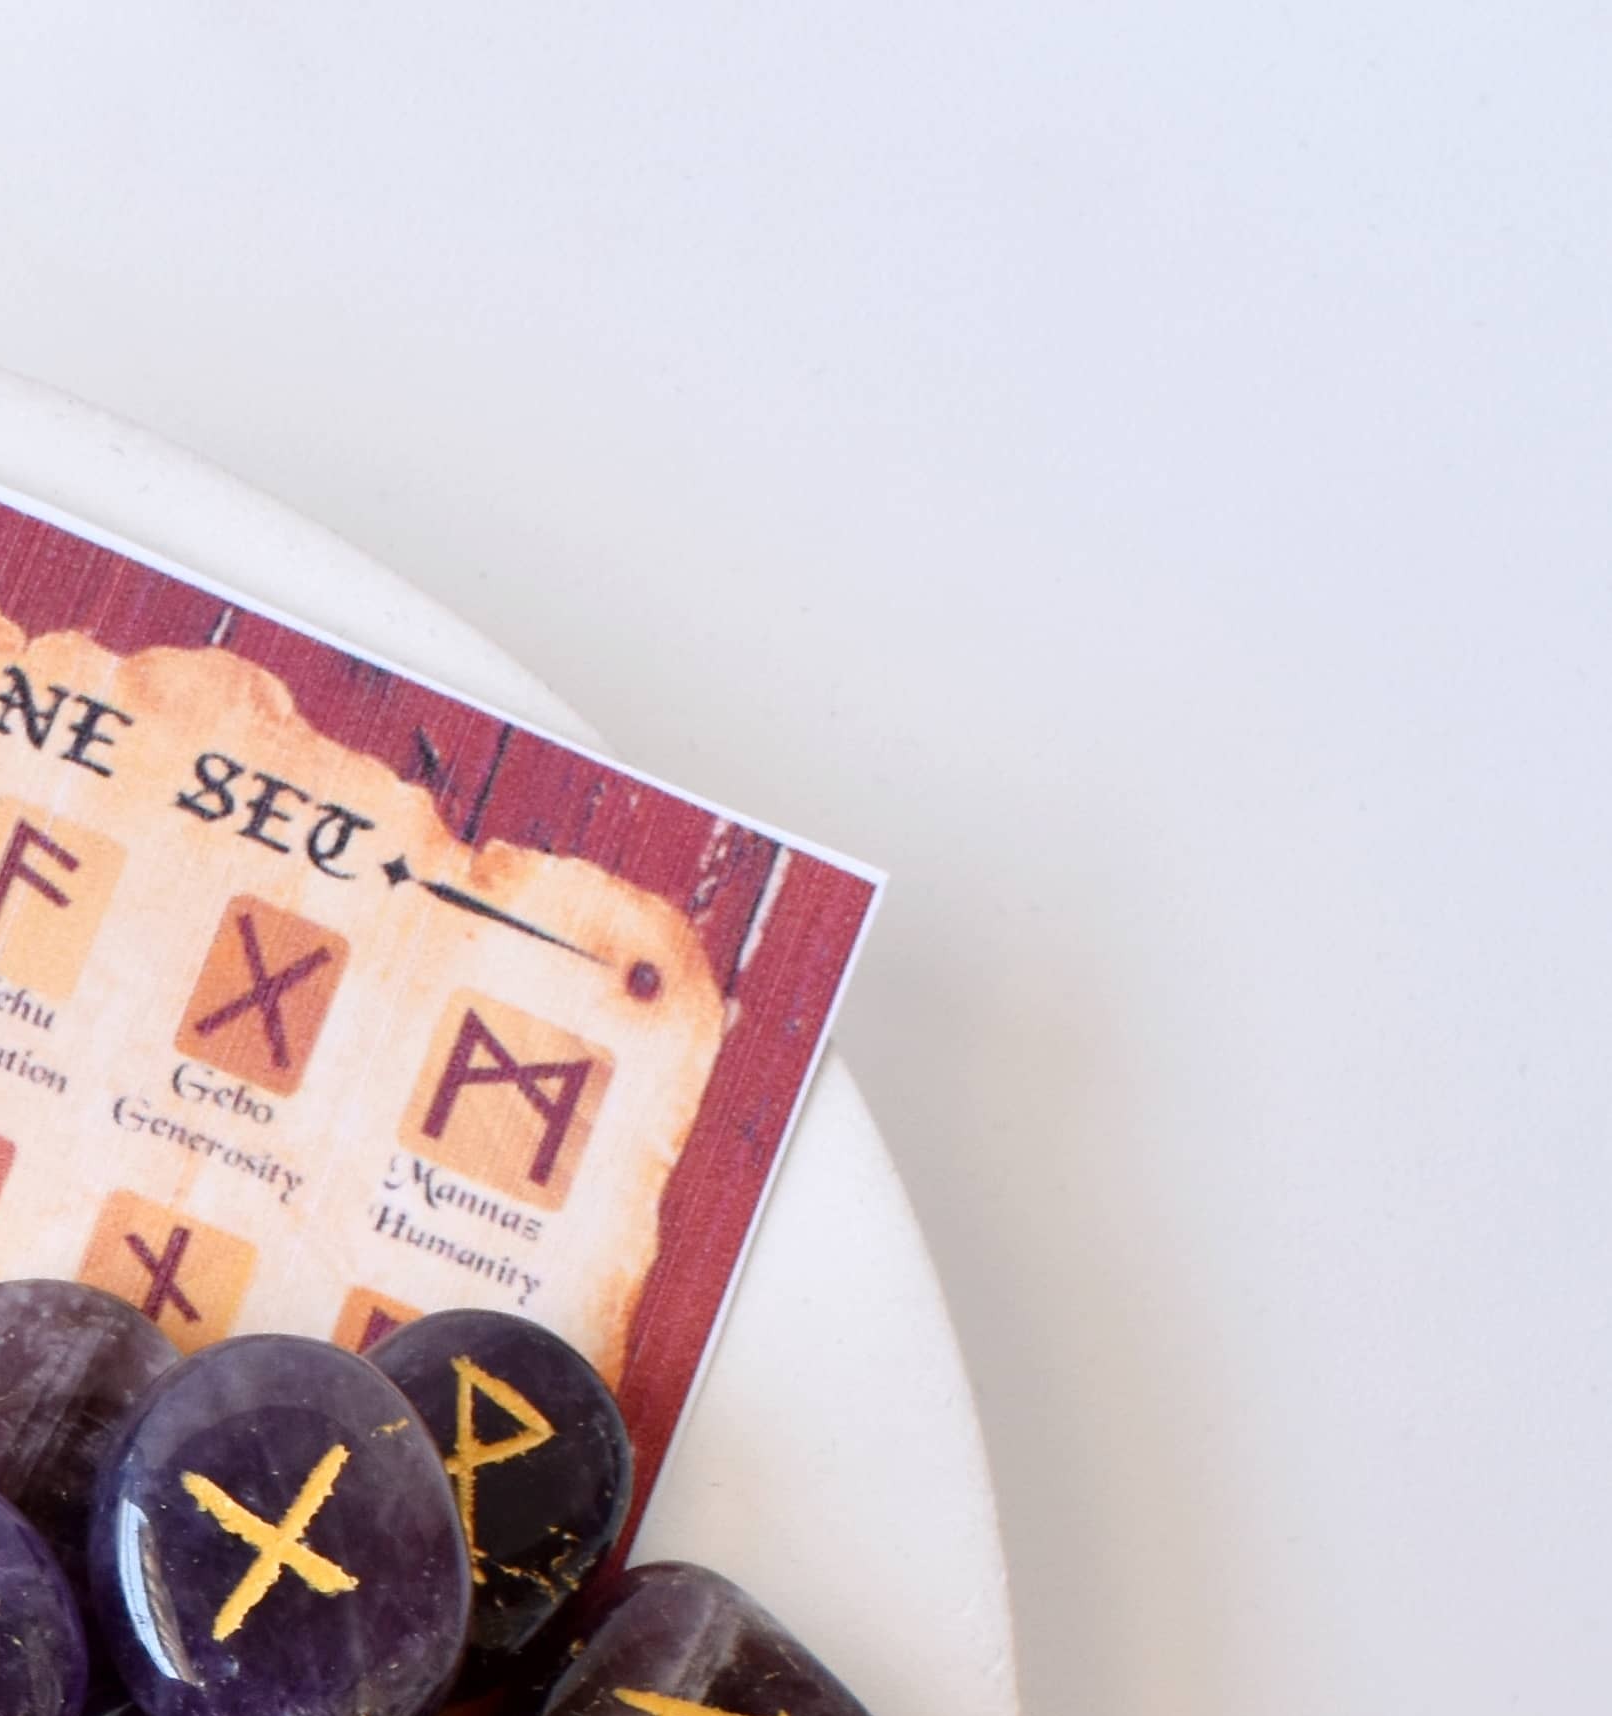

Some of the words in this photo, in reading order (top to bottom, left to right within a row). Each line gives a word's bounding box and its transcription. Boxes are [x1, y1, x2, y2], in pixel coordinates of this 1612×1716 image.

[175, 751, 375, 880] SET
[112, 1094, 304, 1203] Generosity
[369, 1204, 542, 1306] Humanity
